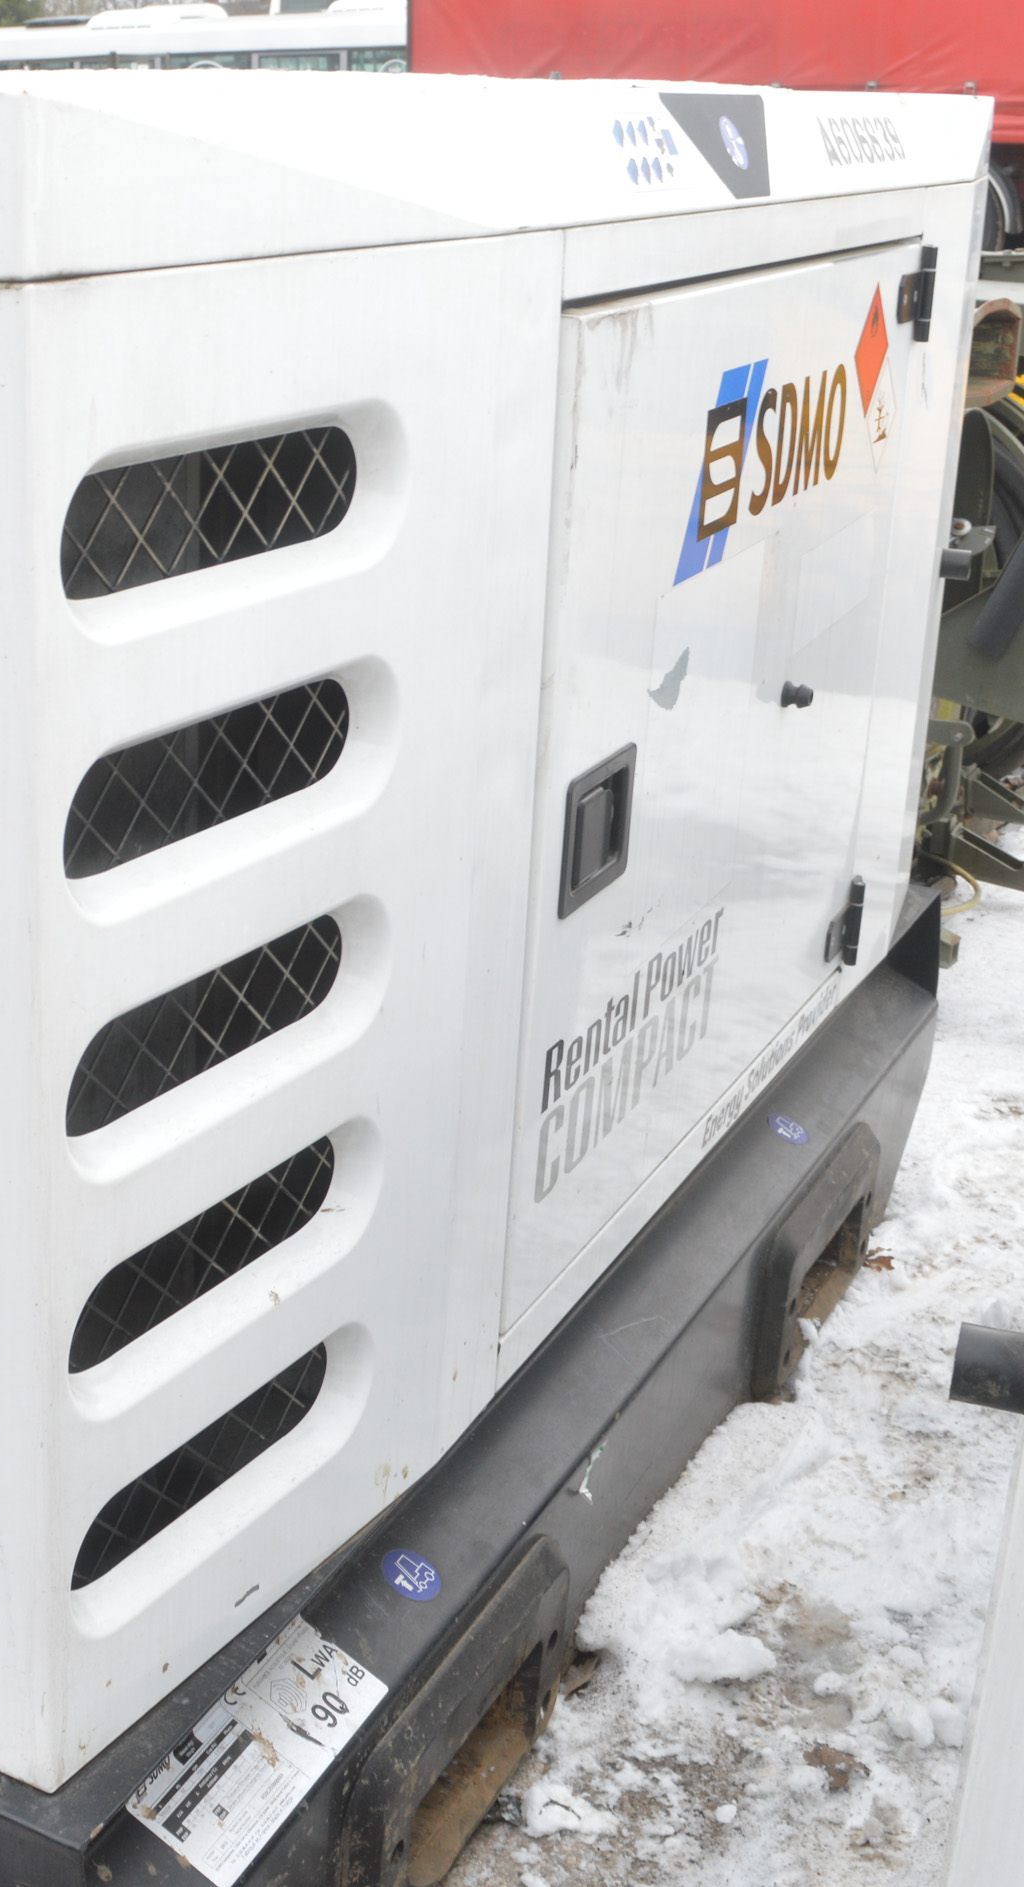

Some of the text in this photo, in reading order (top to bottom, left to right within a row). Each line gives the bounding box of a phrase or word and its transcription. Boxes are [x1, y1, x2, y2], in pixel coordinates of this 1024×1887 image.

[816, 116, 906, 167] A606839
[748, 363, 847, 516] SDMO
[540, 906, 724, 1115] Rental Power
[534, 954, 719, 1204] COMPACT
[701, 1086, 745, 1149] Energy
[744, 1030, 796, 1101] Solutions
[311, 1691, 349, 1728] 90
[346, 1664, 366, 1687] dB
